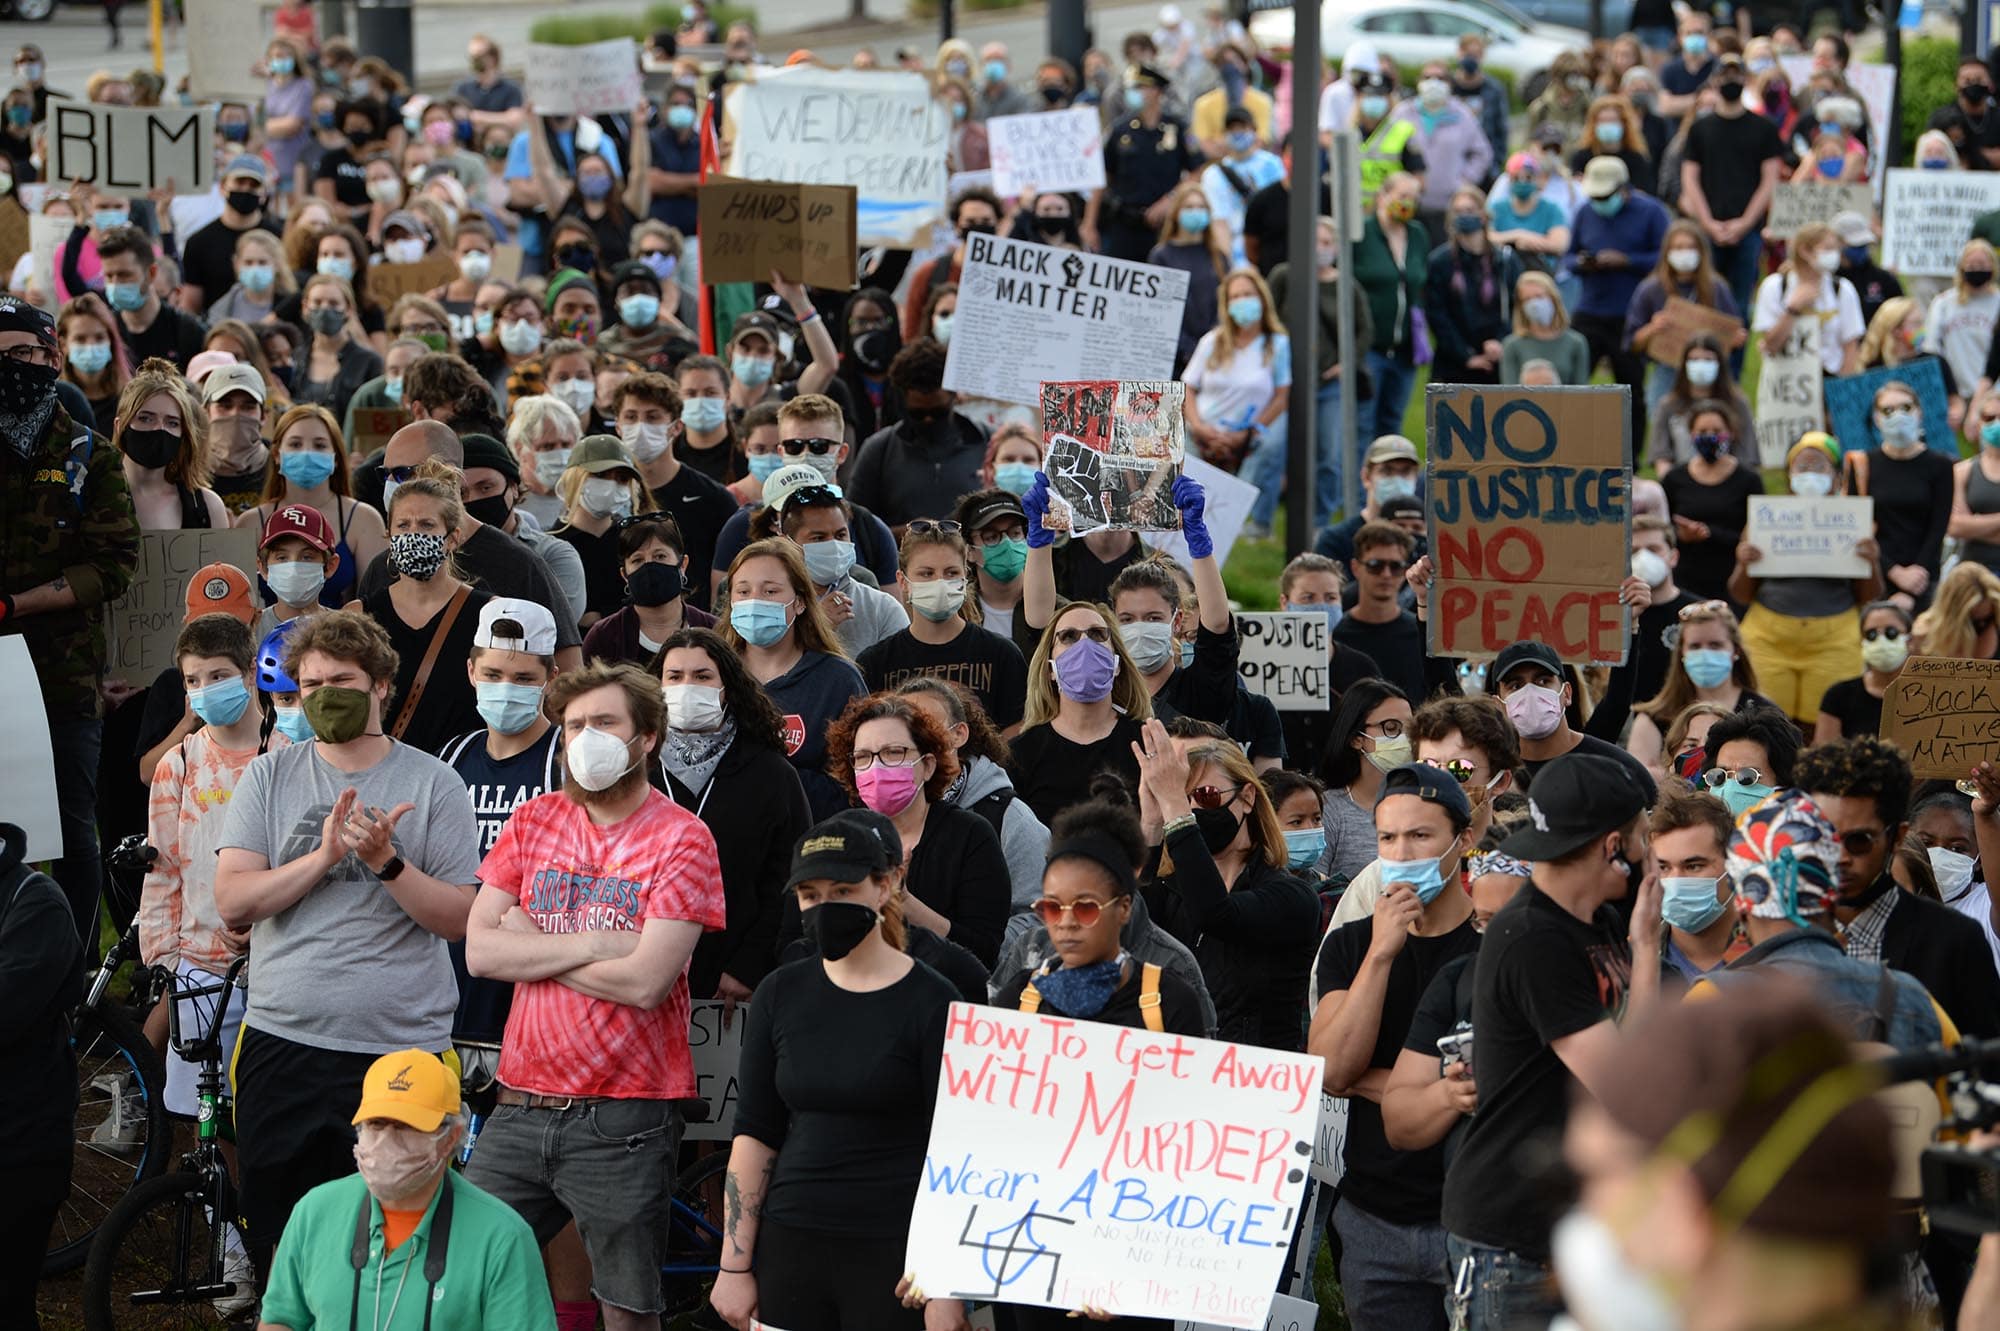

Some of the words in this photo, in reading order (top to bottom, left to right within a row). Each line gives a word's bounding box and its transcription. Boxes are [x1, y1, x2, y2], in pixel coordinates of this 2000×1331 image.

[757, 93, 830, 144] WE
[836, 92, 945, 148] DEMAND
[57, 106, 199, 188] BLM
[721, 191, 800, 224] HANDS
[807, 201, 834, 226] UP
[970, 237, 1052, 276] BLACK
[1089, 262, 1161, 298] LIVES
[995, 277, 1109, 321] MATTER
[1435, 394, 1557, 463] NO
[780, 471, 815, 487] BOSTON
[1434, 467, 1624, 525] JUSTICE
[282, 507, 306, 527] FSU
[1438, 526, 1544, 583] NO
[129, 611, 175, 632] FROM
[1263, 616, 1326, 652] JUSTICE
[1441, 586, 1622, 663] PEACE
[914, 662, 993, 693] ZEPPELIN
[1262, 661, 1327, 700] PEACE
[1896, 682, 2000, 717] Black
[943, 1052, 1060, 1119] With
[1040, 1017, 1088, 1059] To
[1115, 1028, 1196, 1079] Get
[1212, 1045, 1316, 1114] Away
[927, 1153, 1040, 1202] Wear
[1058, 1168, 1099, 1219] A
[1093, 1225, 1121, 1241] No
[1127, 1247, 1153, 1264] No
[1192, 1280, 1268, 1315] Police
